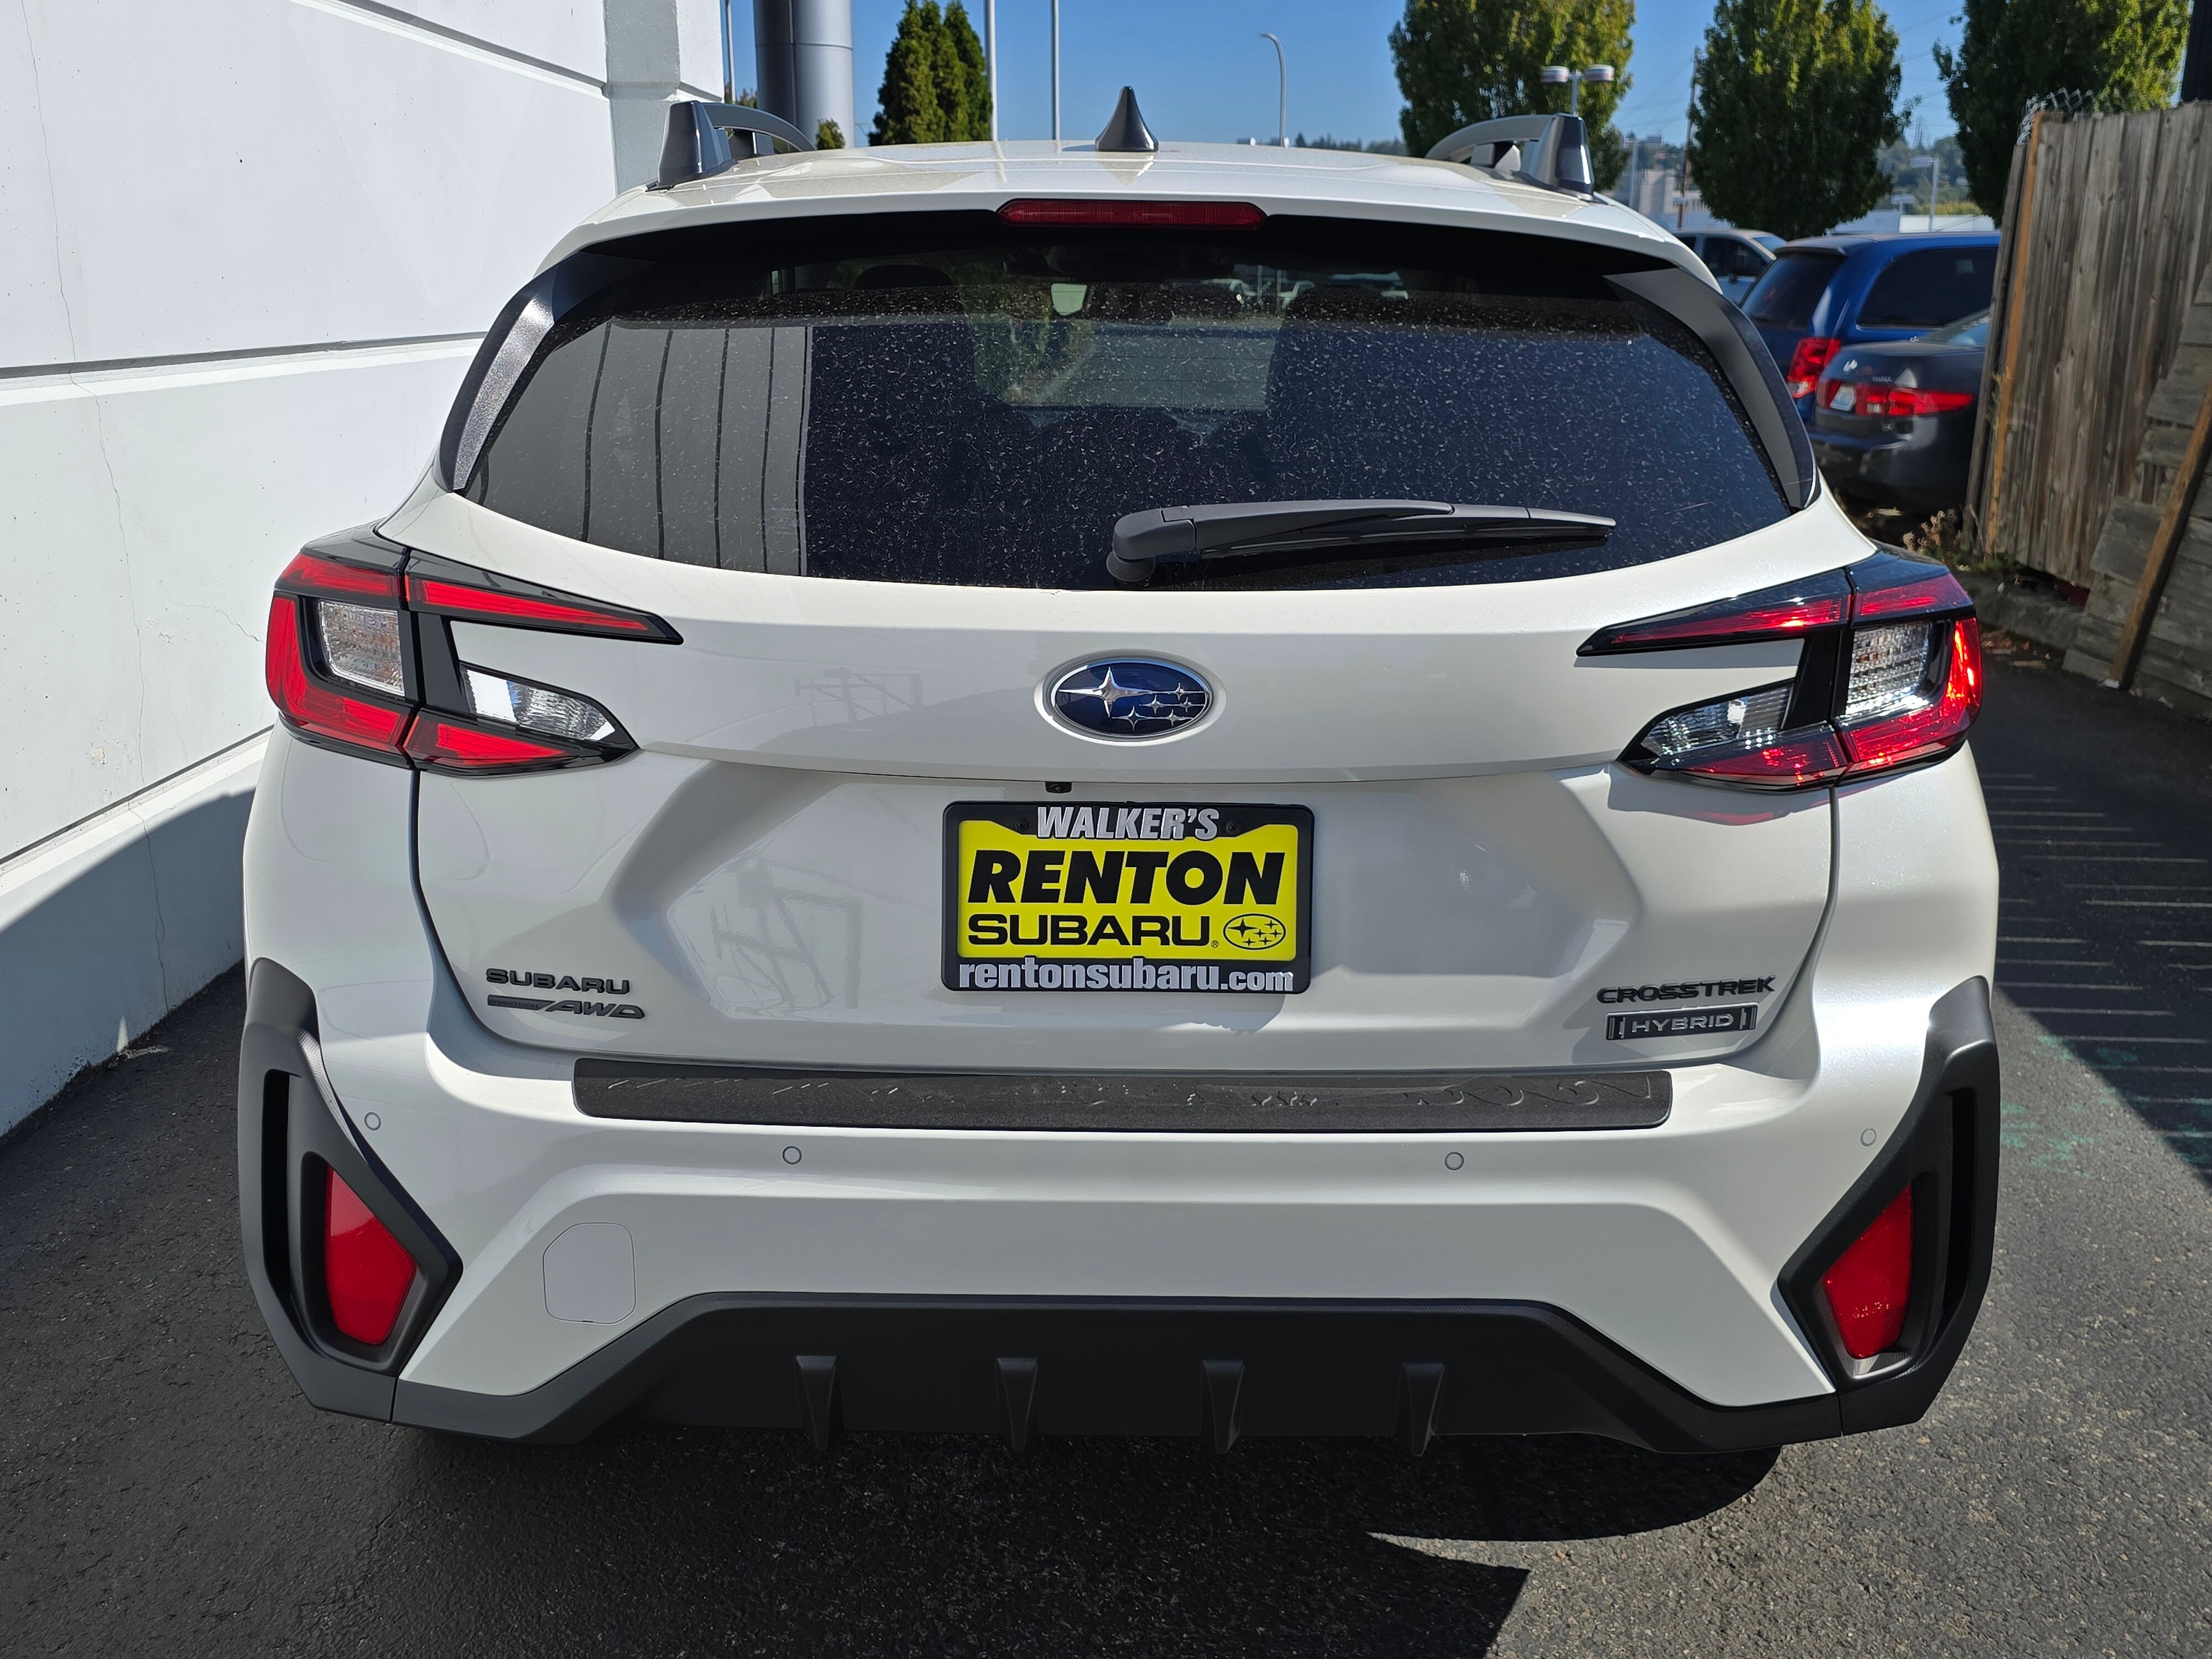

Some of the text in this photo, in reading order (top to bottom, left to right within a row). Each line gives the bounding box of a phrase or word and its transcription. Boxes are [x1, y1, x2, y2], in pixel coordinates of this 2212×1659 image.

[1037, 806, 1219, 841] WALKER'S
[968, 849, 1285, 905] RENTON
[486, 968, 630, 994] SUBARU
[959, 958, 1293, 992] rentonsubaru.com
[1597, 975, 1776, 1004] CROSSTREK
[545, 1000, 645, 1019] AWD
[1631, 1013, 1734, 1032] HYBRID
